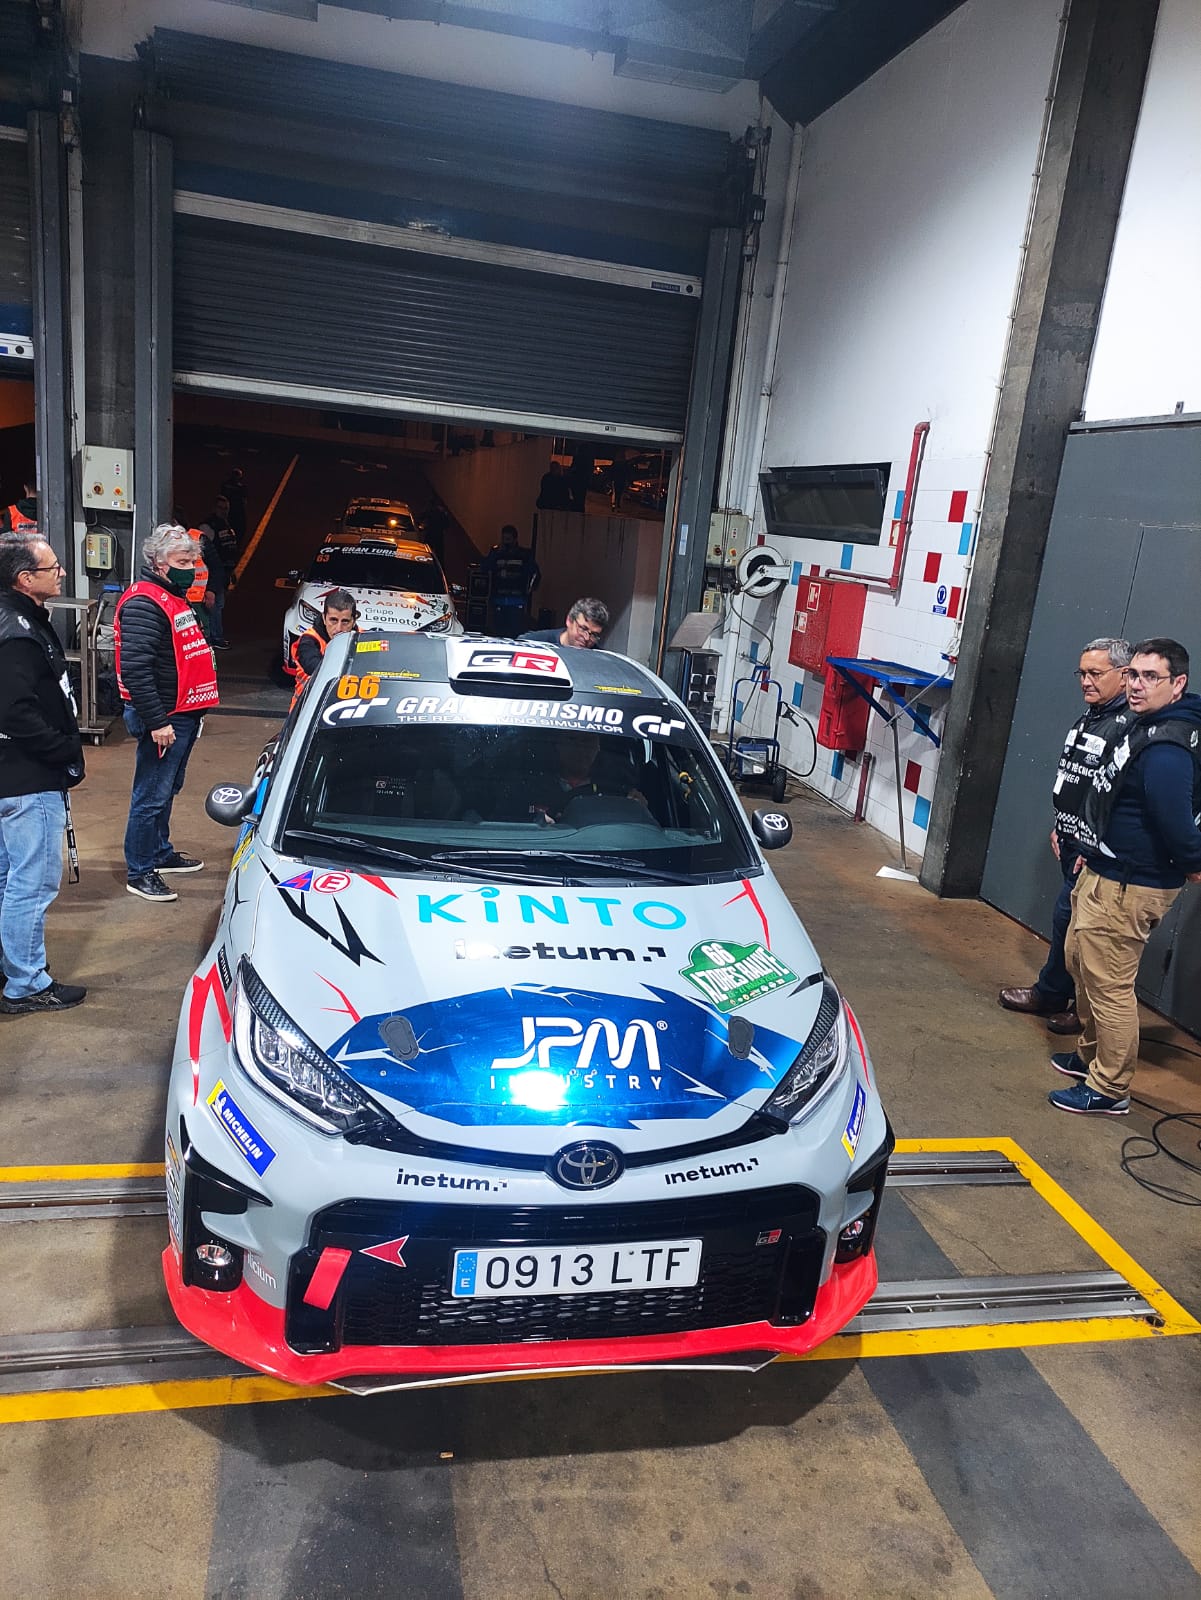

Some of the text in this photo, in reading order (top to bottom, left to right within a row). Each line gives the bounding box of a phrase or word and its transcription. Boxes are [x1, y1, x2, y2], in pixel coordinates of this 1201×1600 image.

[316, 554, 330, 563] 63
[342, 546, 368, 554] GRAN
[365, 607, 394, 616] Grupo
[375, 600, 437, 617] ASTURIAS
[365, 614, 423, 628] Leomotor
[469, 652, 557, 672] GR
[336, 674, 381, 699] 66
[395, 696, 624, 726] GRA URISMO
[540, 718, 624, 734] SIMULATOR
[700, 942, 736, 967] 66
[689, 966, 749, 1004] AZORES
[734, 945, 790, 982] RALLYE
[489, 1074, 662, 1091] IUSTRY
[222, 1105, 264, 1161] MICHELIN
[485, 1247, 690, 1290] 0913 LTF
[460, 1277, 470, 1288] E
